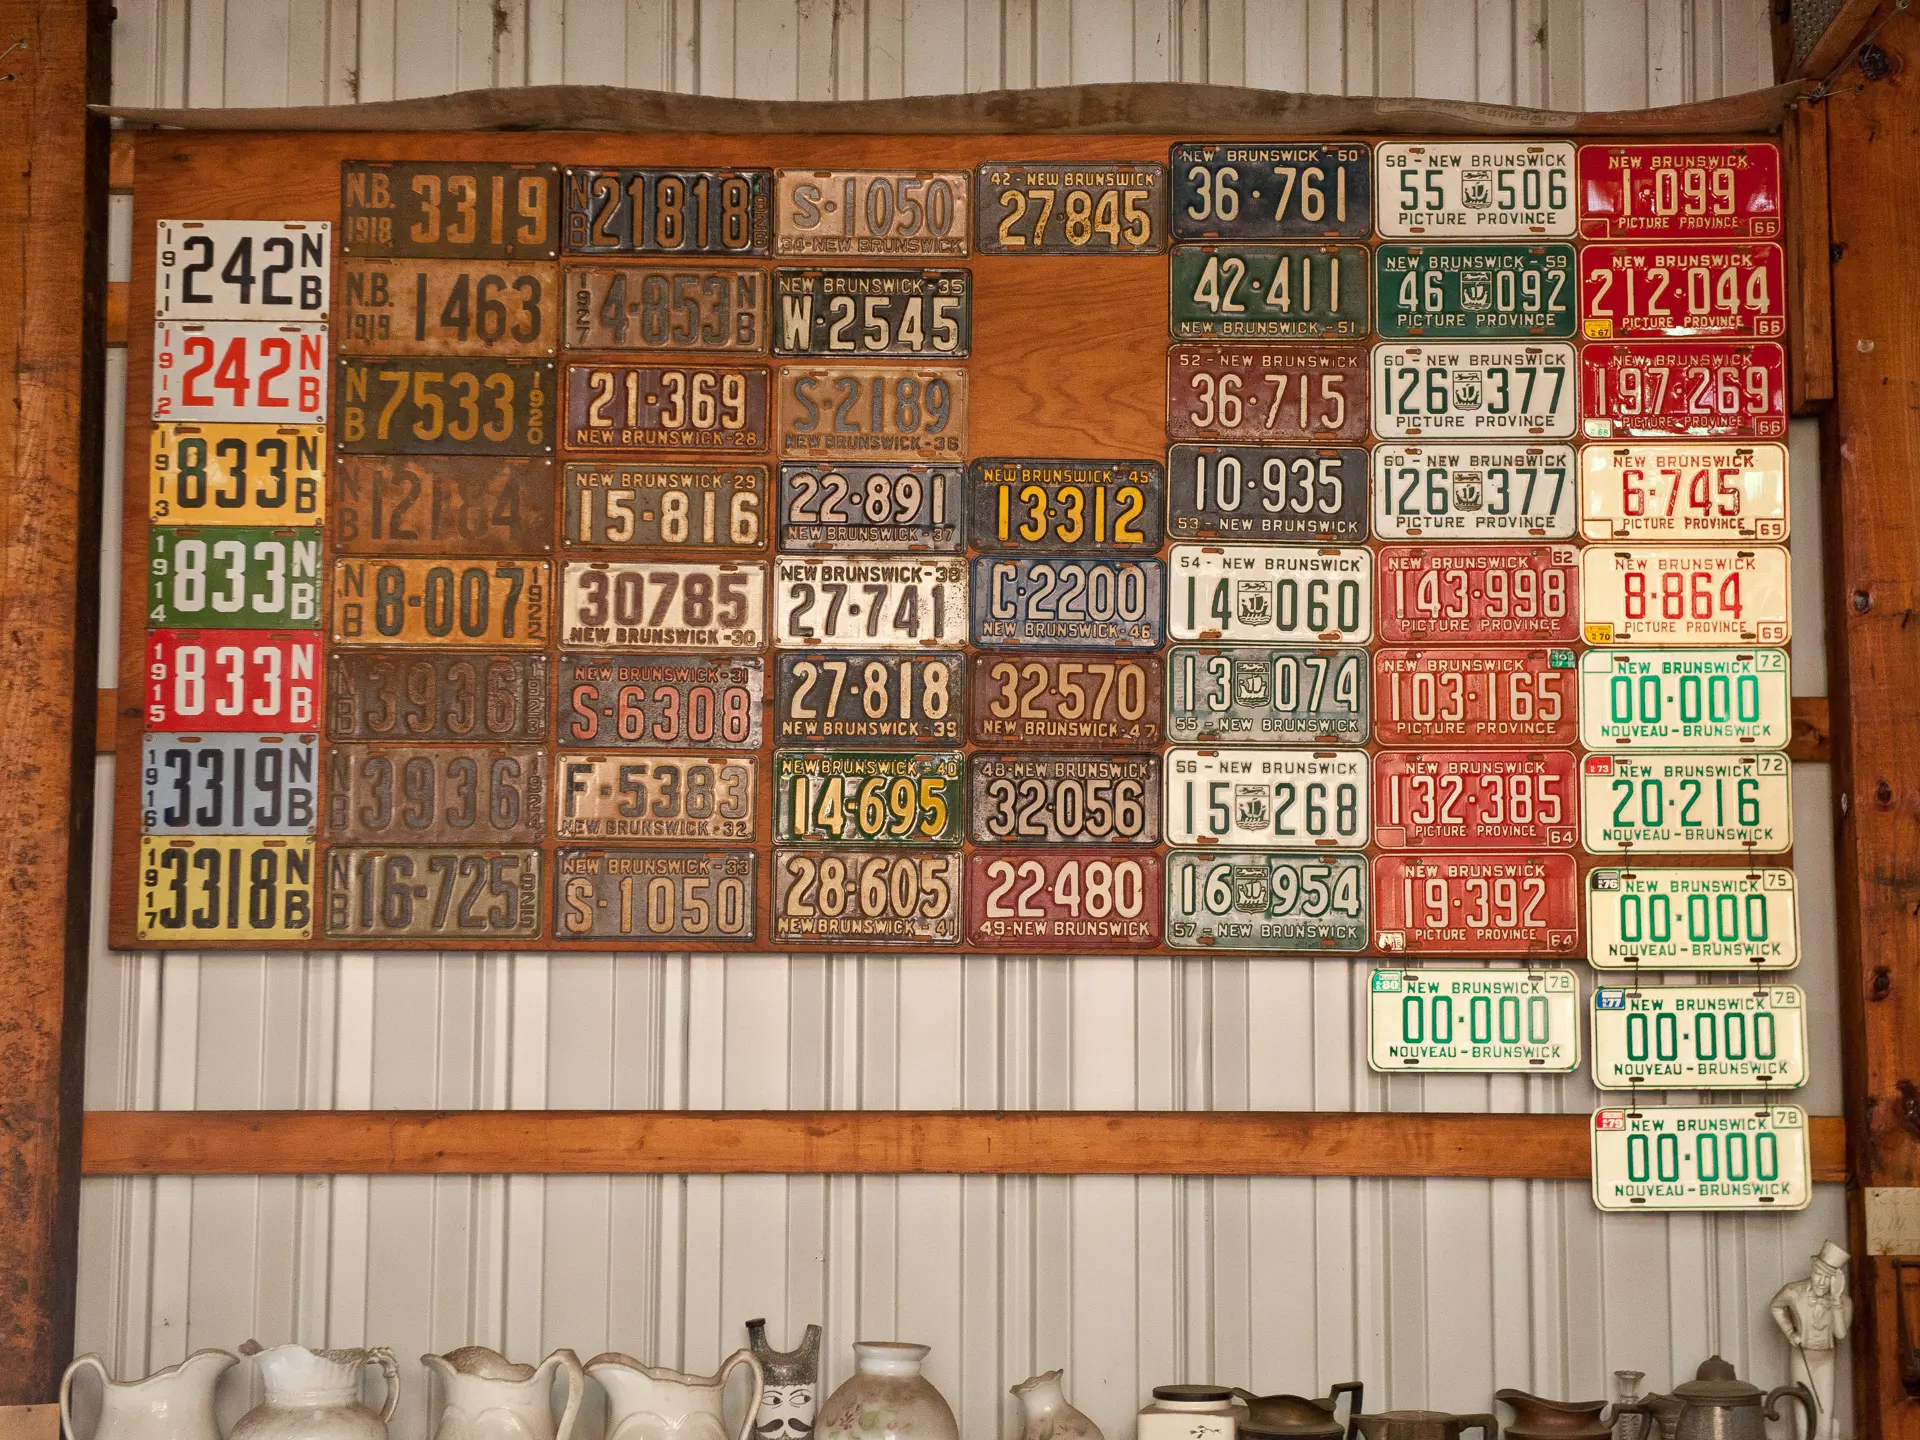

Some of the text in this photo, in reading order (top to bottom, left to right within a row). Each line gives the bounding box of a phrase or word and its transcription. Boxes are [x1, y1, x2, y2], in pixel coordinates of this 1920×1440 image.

[1027, 174, 1059, 186] NEW
[1065, 174, 1154, 186] BRUNSWICK
[1429, 155, 1460, 167] NEW
[1471, 155, 1566, 166] BRUNSWICK
[1609, 156, 1747, 167] NEW BRUNSWICK
[347, 173, 395, 208] N.B.
[411, 175, 549, 244] 3319
[1401, 170, 1566, 210] 55 506
[347, 217, 392, 243] 1918
[592, 177, 750, 248] 21818
[1399, 213, 1556, 225] PICTURE PROVINCE
[1755, 221, 1776, 233] 66
[161, 229, 174, 311] 1911
[182, 237, 295, 305] 242
[300, 234, 322, 310] NB
[345, 273, 394, 307] N.B.
[780, 279, 816, 292] NEW
[1401, 271, 1566, 312] 46 092
[346, 314, 391, 340] 1919
[416, 273, 542, 341] 1463
[1182, 321, 1319, 334] NEW BRUNSWICK
[1759, 321, 1780, 333] 66
[158, 325, 174, 415] 1912
[182, 337, 291, 407] 242
[299, 335, 321, 412] NB
[1385, 368, 1565, 415] 126 377
[346, 368, 367, 442] NB
[377, 371, 514, 440] 7533
[577, 431, 614, 445] NEW
[1759, 421, 1780, 433] 66
[155, 431, 170, 517] 1913
[177, 438, 288, 508] 833
[295, 436, 318, 513] NB
[985, 470, 1015, 482] NEW
[1022, 470, 1112, 483] BRUNSWICK
[1614, 456, 1754, 468] NEW BRUNSWICK
[1385, 469, 1566, 515] 126 377
[1623, 518, 1744, 529] PICTURE PROVINCE
[1761, 524, 1781, 536] 69
[174, 540, 286, 613] 833
[1223, 558, 1255, 569] NEW
[1265, 559, 1359, 571] BRUNSWICK
[1389, 557, 1528, 570] NEW BRUNSWICK
[1553, 552, 1573, 563] 62
[150, 538, 167, 621] 1914
[291, 541, 316, 620] NB
[344, 565, 364, 637] NB
[579, 572, 748, 627] 30785
[1187, 577, 1359, 631] 14 060
[1401, 619, 1560, 631] PICTURE PROVINCE
[1762, 627, 1782, 639] 69
[174, 646, 282, 716] 833
[1761, 655, 1781, 667] 72
[148, 645, 167, 722] 1915
[291, 644, 313, 723] NB
[367, 662, 515, 733] 3936
[1184, 658, 1356, 711] 13 074
[1763, 759, 1782, 771] 72
[143, 749, 157, 827] 1916
[164, 748, 282, 827] 3319
[288, 748, 313, 826] NB
[364, 756, 520, 830] 3936
[1186, 783, 1356, 835] 15 268
[1551, 831, 1573, 844] 64
[143, 852, 158, 930] 1917
[159, 848, 278, 929] 3318
[285, 848, 310, 929] NB
[1183, 865, 1359, 916] 16 954
[1604, 880, 1617, 888] 76
[1768, 874, 1786, 887] 75
[1552, 935, 1573, 948] 64
[1549, 975, 1569, 988] 78
[1776, 992, 1795, 1004] 78
[1631, 998, 1765, 1010] NEW BRUNSWICK
[1607, 1119, 1623, 1128] 79
[1777, 1111, 1797, 1123] 78
